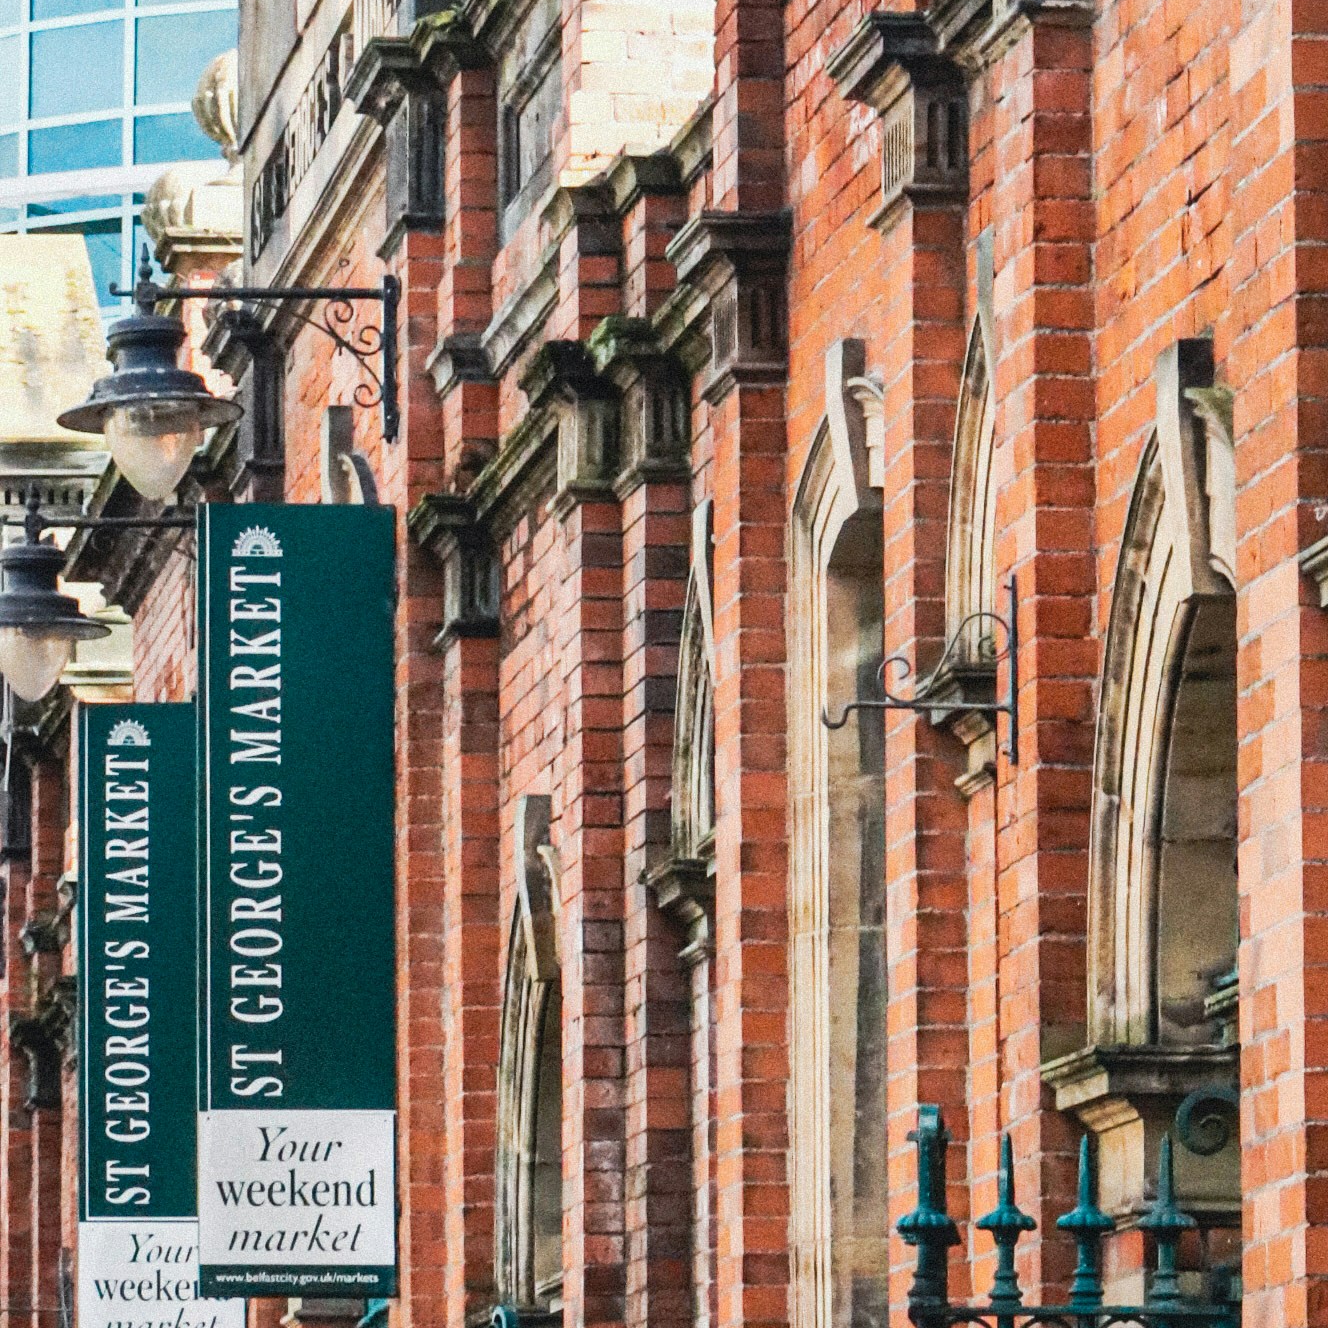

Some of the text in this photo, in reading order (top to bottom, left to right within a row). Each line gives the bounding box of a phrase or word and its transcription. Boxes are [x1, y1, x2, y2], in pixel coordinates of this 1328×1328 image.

[229, 566, 284, 1097] ST GEORGE'S MARKET
[104, 754, 151, 1205] ST GEORGE'S MARKET
[258, 1126, 343, 1163] Your
[216, 1168, 377, 1207] weekend
[130, 1233, 199, 1264] Your
[228, 1213, 362, 1252] market
[94, 1269, 199, 1301] weeke
